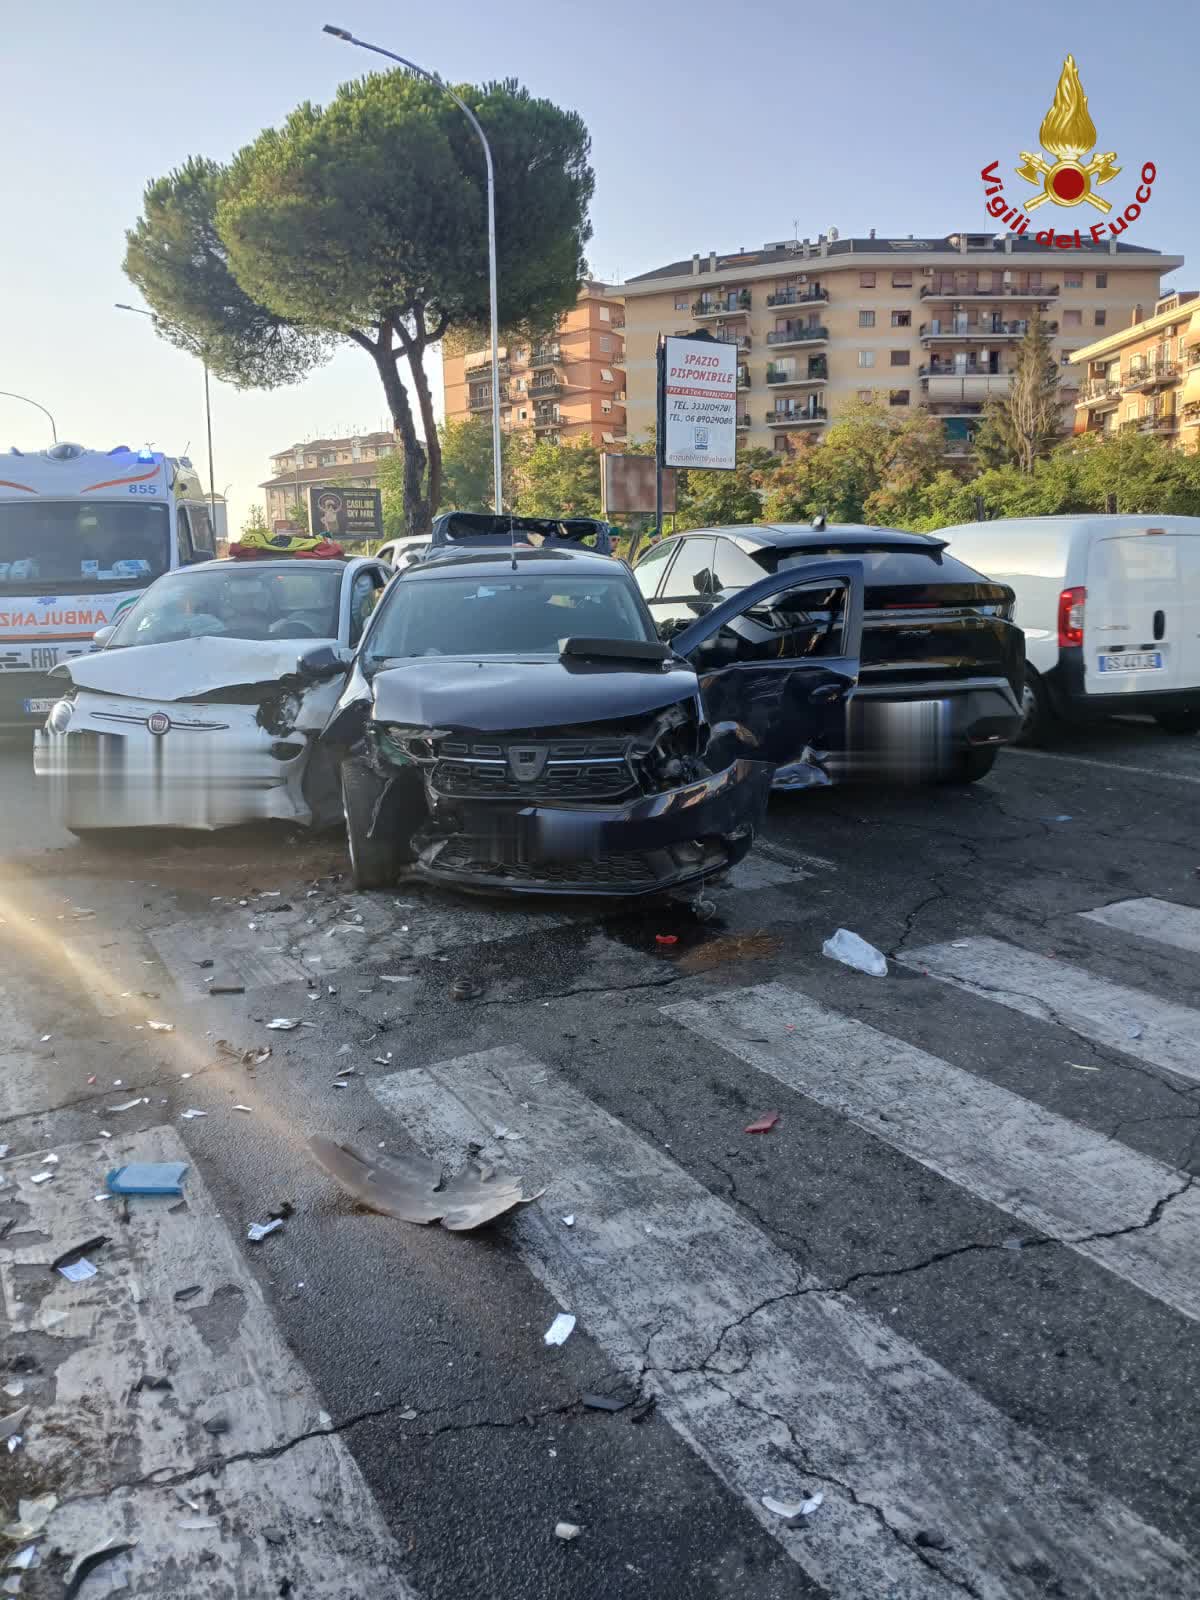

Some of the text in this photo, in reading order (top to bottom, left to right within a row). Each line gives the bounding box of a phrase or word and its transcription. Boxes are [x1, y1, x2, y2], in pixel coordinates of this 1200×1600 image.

[684, 354, 720, 368] SPAZIO
[670, 367, 734, 383] DISPONIBILE
[669, 387, 681, 395] PER
[681, 388, 690, 396] LA
[673, 400, 689, 410] TEL.
[669, 413, 683, 423] TEL.
[685, 414, 696, 423] 06
[128, 484, 157, 495] 855
[31, 647, 59, 669] FIAT
